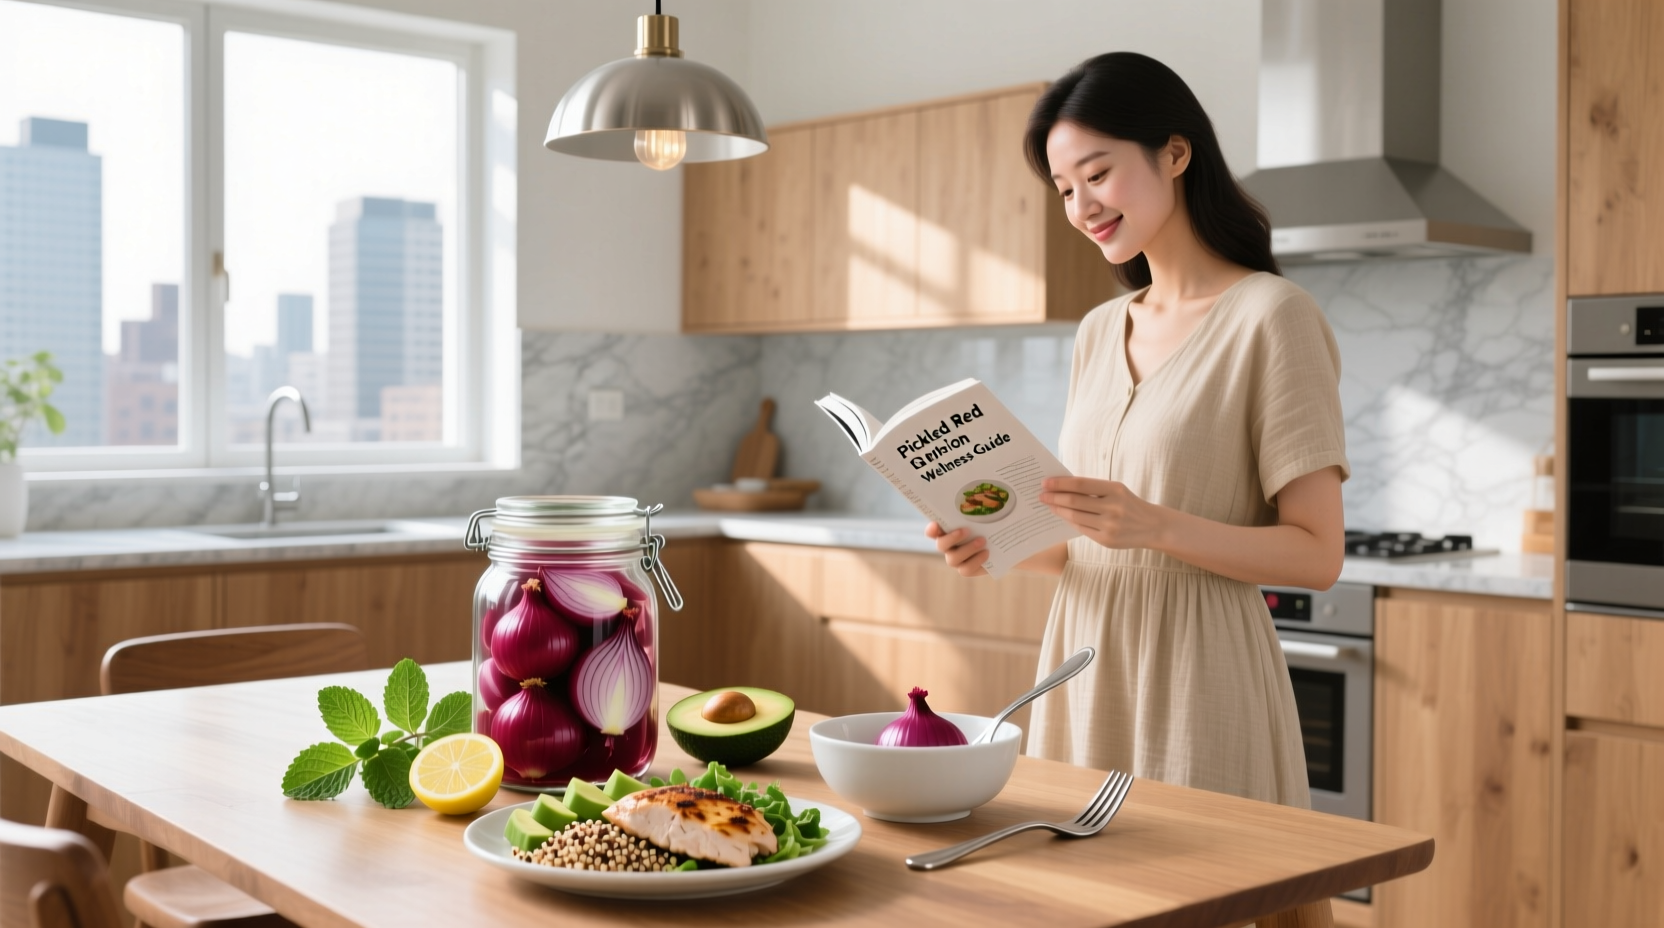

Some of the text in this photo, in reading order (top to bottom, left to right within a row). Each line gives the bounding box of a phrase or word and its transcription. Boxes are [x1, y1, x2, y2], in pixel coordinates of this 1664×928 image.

[897, 403, 984, 459] Pickled Red
[973, 433, 1011, 455] Guide
